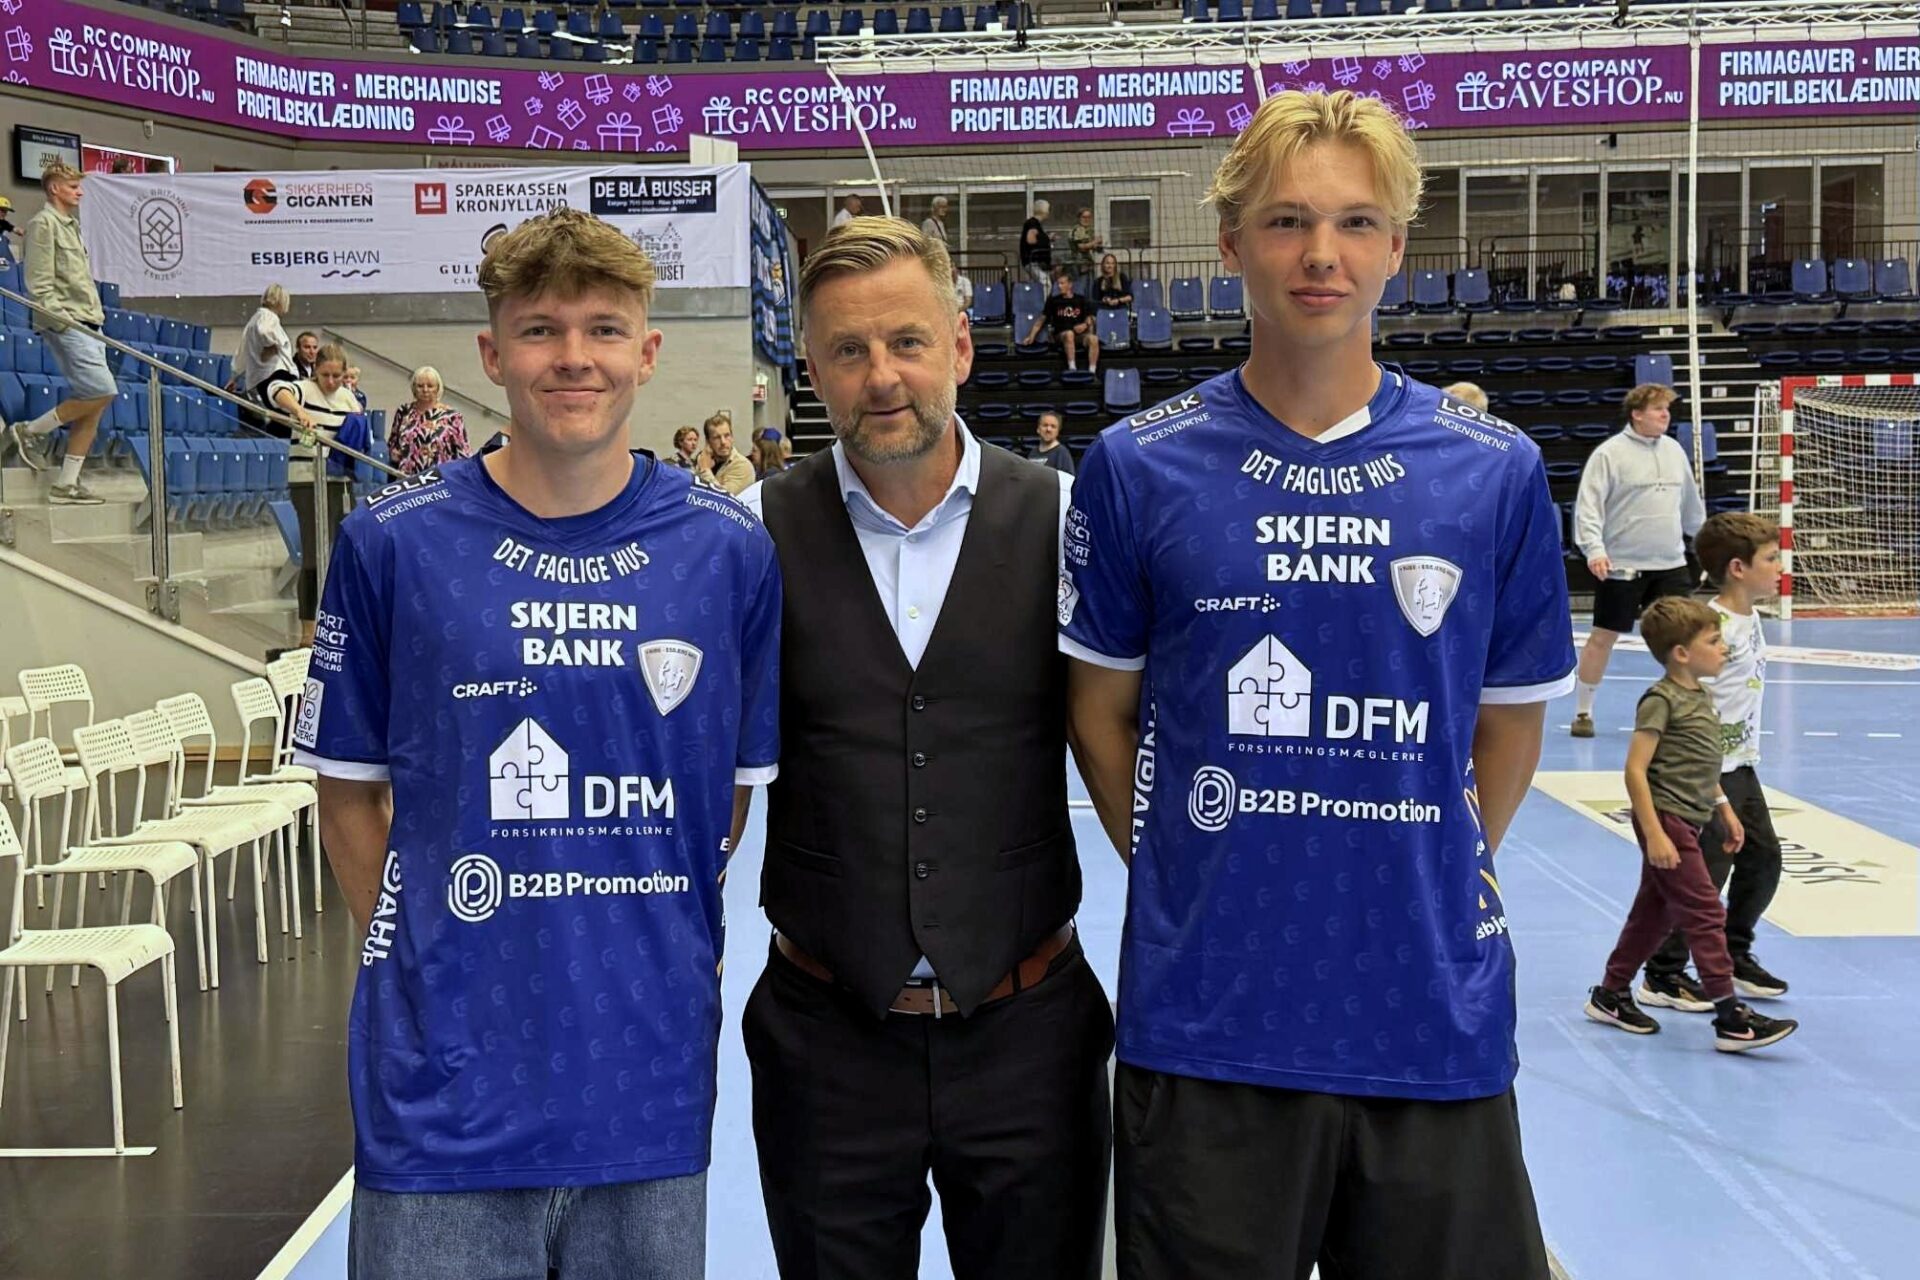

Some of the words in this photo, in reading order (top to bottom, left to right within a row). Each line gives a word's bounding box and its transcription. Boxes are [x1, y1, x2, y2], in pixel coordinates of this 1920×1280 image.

[83, 24, 107, 48] RC
[110, 32, 192, 67] COMPANY
[1720, 48, 1855, 76] FIRMAGAVER
[70, 44, 215, 104] GAVESHOP.NU
[235, 56, 336, 97] FIRMAGAVER
[355, 73, 502, 105] MERCHANDISE
[1502, 62, 1532, 80] RC
[1537, 58, 1652, 79] COMPANY
[745, 88, 773, 105] RC
[778, 85, 886, 104] COMPANY
[950, 72, 1079, 103] FIRMAGAVER
[1097, 69, 1244, 99] MERCHANDISE
[1482, 76, 1684, 110] GAVESHOP.NU
[236, 88, 415, 132] PROFILBEKLÆDNING
[950, 102, 1156, 133] PROFILBEKLÆDNING
[285, 182, 373, 195] SIKKERHEDS
[286, 194, 373, 208] GIGANTEN
[455, 183, 567, 197] SPAREKASSEN
[594, 181, 615, 198] DE
[618, 176, 648, 198] BLÅ
[651, 180, 712, 197] BUSSER
[251, 251, 329, 268] ESBJERG
[333, 250, 380, 265] HAVN
[1130, 394, 1199, 427] LOLK
[1136, 412, 1211, 446] INGENIØRNE
[1433, 415, 1511, 452] INGENIØRNE
[366, 470, 439, 504] LOLK
[1240, 449, 1282, 485] DET
[1282, 463, 1364, 495] FAGLIGE
[1364, 453, 1406, 488] HUS
[375, 489, 452, 523] INGENIØRNE
[686, 493, 754, 532] INGENIØRNE
[1255, 515, 1390, 549] SKJERN
[492, 537, 534, 572] DET
[534, 553, 611, 583] FAGLIGE
[611, 542, 650, 577] HUS
[1267, 553, 1375, 584] BANK
[510, 602, 637, 635] SKJERN
[1194, 596, 1261, 612] CRAFT
[523, 638, 625, 667] BANK
[452, 680, 518, 699] CRAFT
[1325, 695, 1430, 744] DFM
[1228, 743, 1424, 762] FORSIKRINGSMÆGLERNE
[584, 775, 675, 819] DFM
[1239, 790, 1296, 814] B2B
[1301, 792, 1441, 824] Promotion
[491, 825, 673, 838] FORSIKRINGSMÆGLERNE
[508, 873, 563, 898] B2B
[567, 868, 689, 896] Promotion
